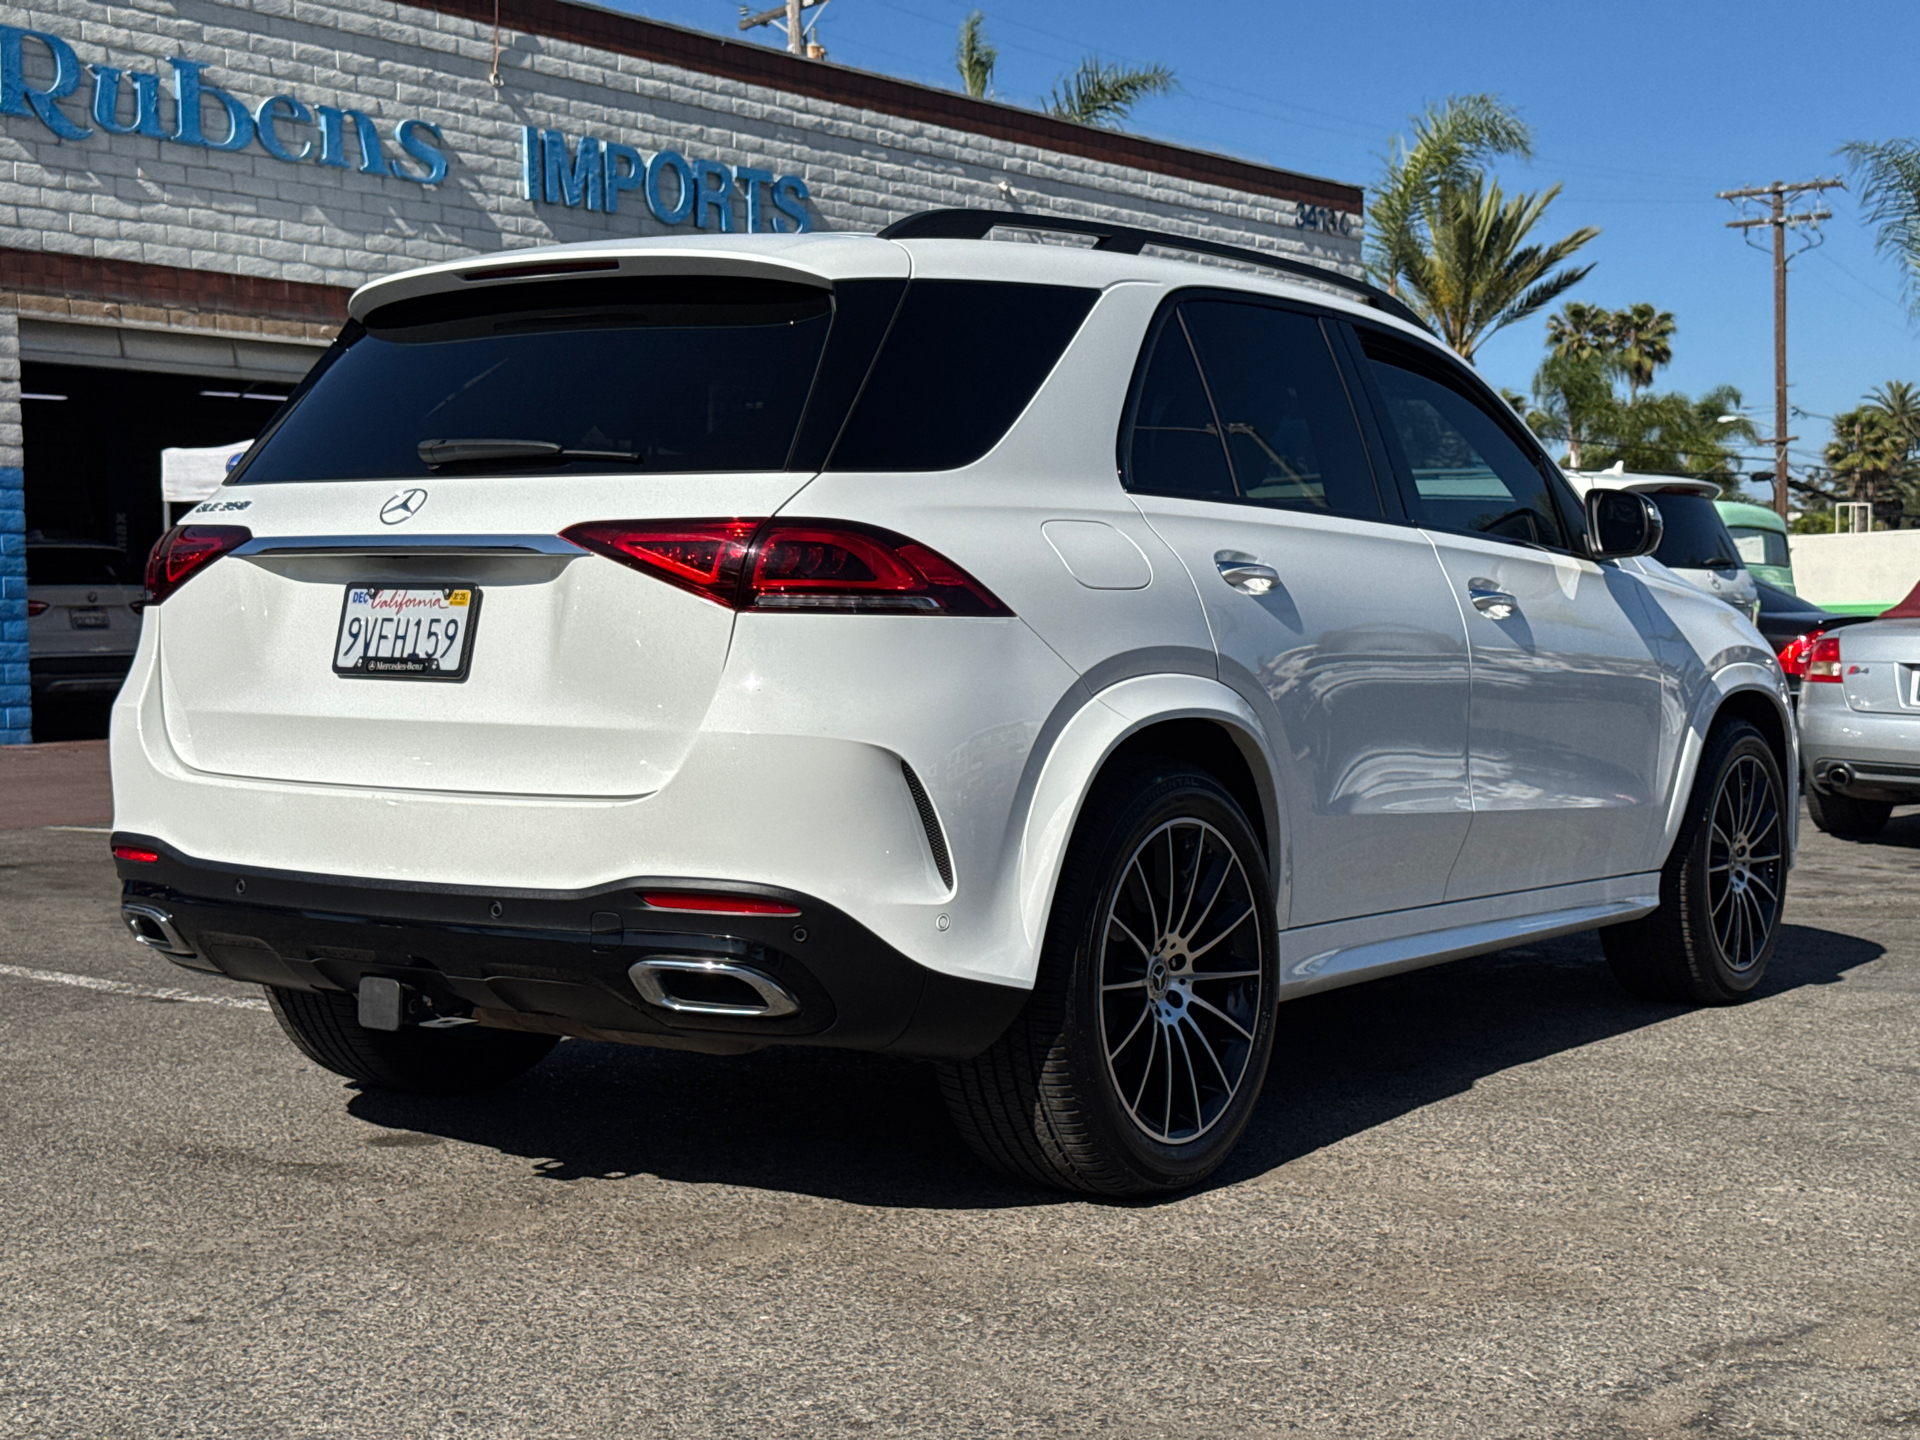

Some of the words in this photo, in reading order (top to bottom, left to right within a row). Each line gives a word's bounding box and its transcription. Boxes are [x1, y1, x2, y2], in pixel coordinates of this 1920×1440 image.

[0, 24, 448, 184] Rubens
[522, 125, 812, 233] IMPORTS
[371, 589, 450, 616] California
[343, 617, 459, 659] 9VFH159
[376, 661, 424, 671] Mercedes-Benz
